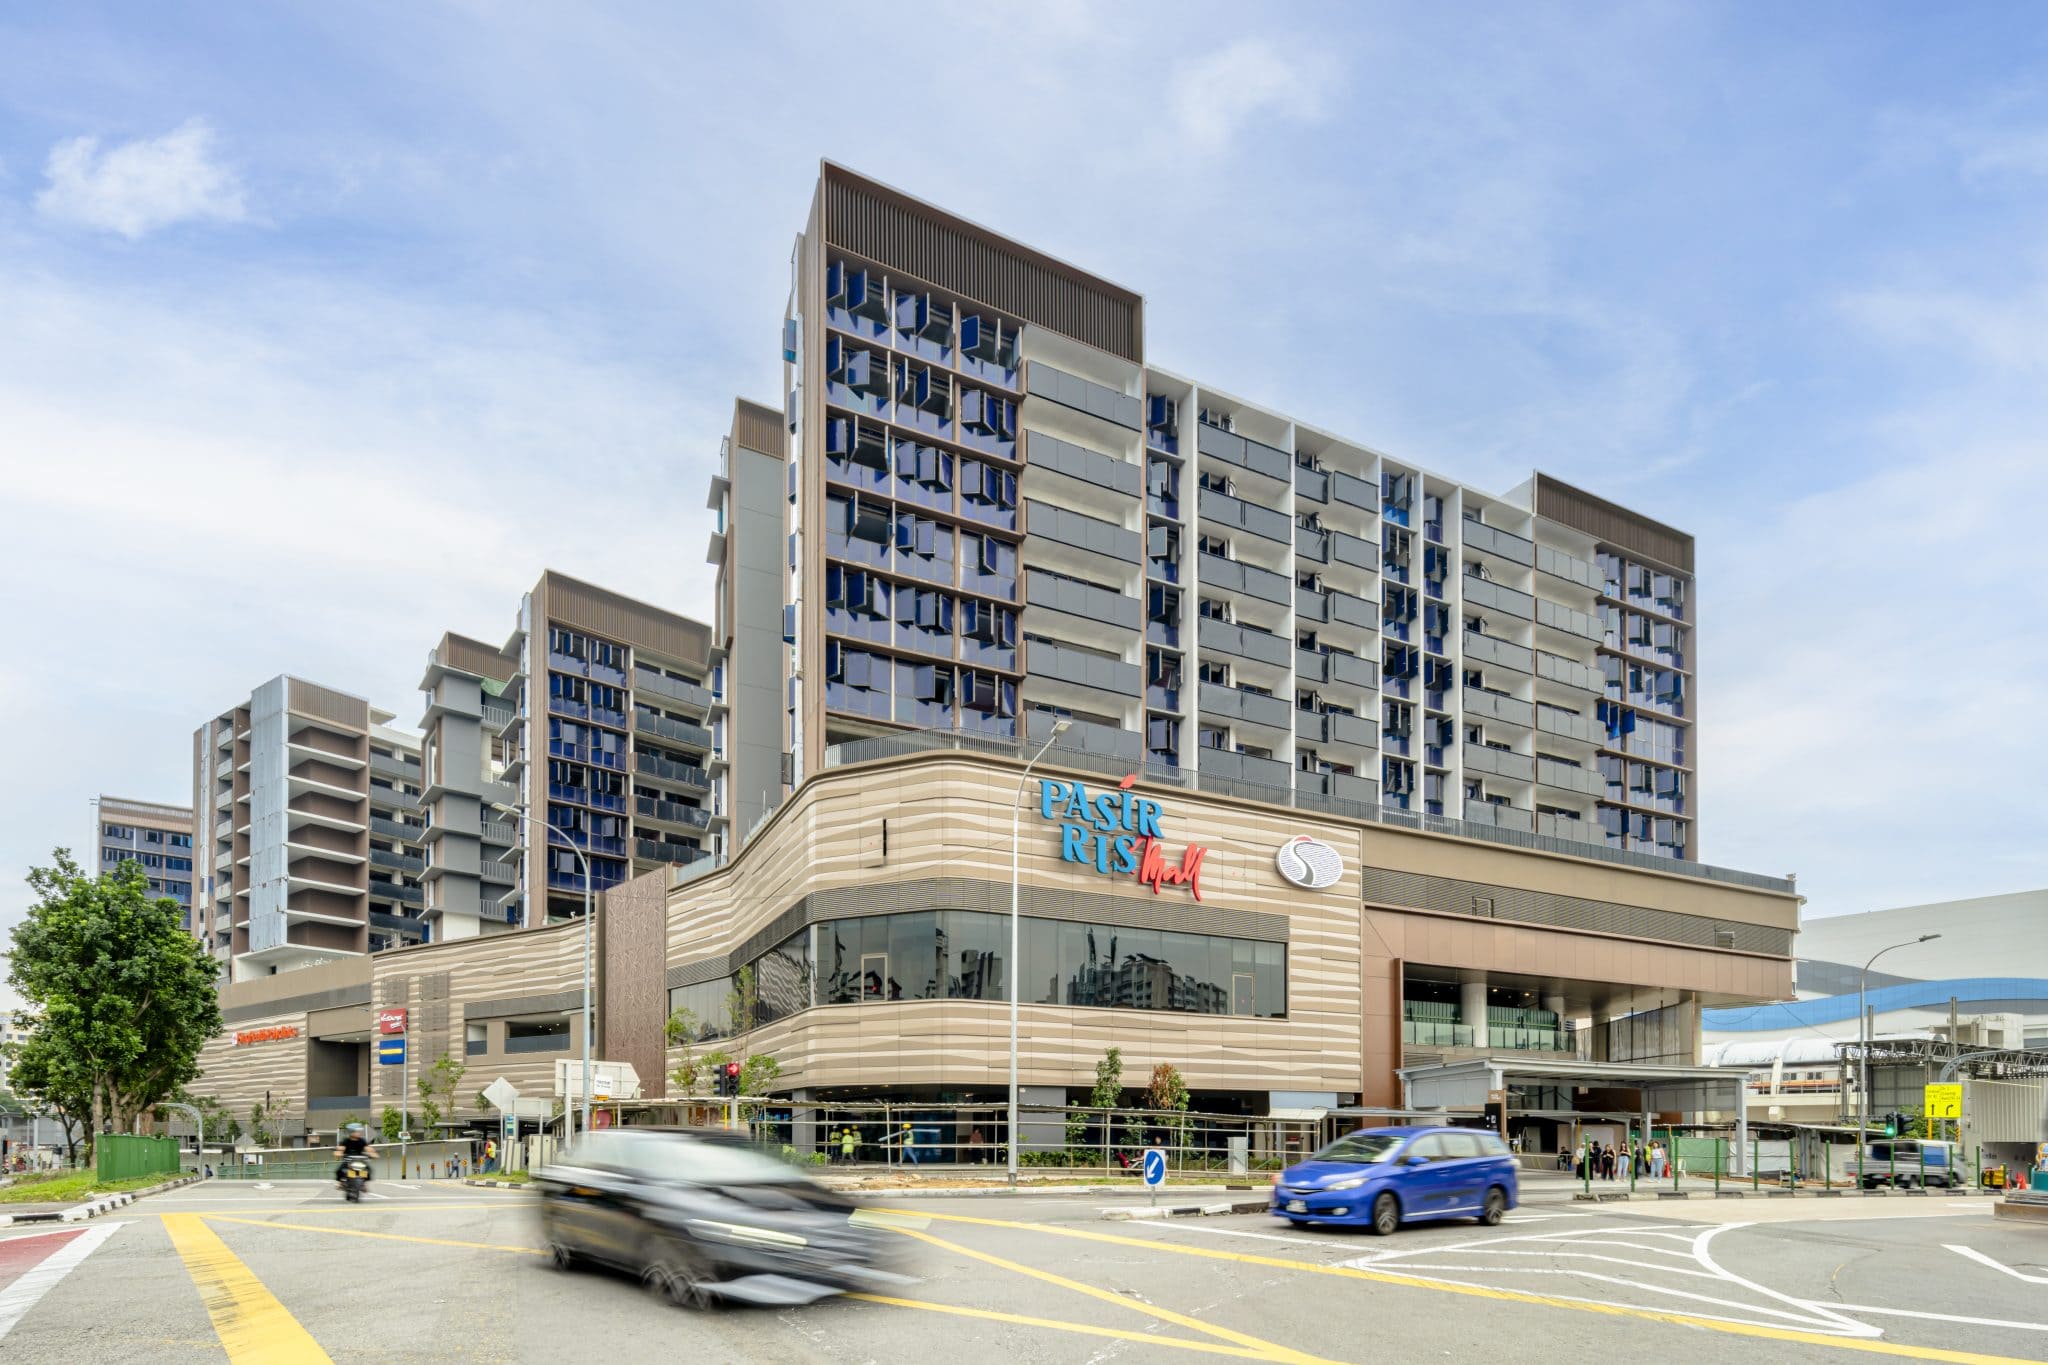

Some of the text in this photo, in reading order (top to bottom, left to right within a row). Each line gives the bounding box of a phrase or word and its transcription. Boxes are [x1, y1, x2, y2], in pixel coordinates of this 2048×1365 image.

[1039, 774, 1164, 838] PASIR
[1060, 823, 1136, 874] RIS
[1130, 835, 1207, 901] Mall
